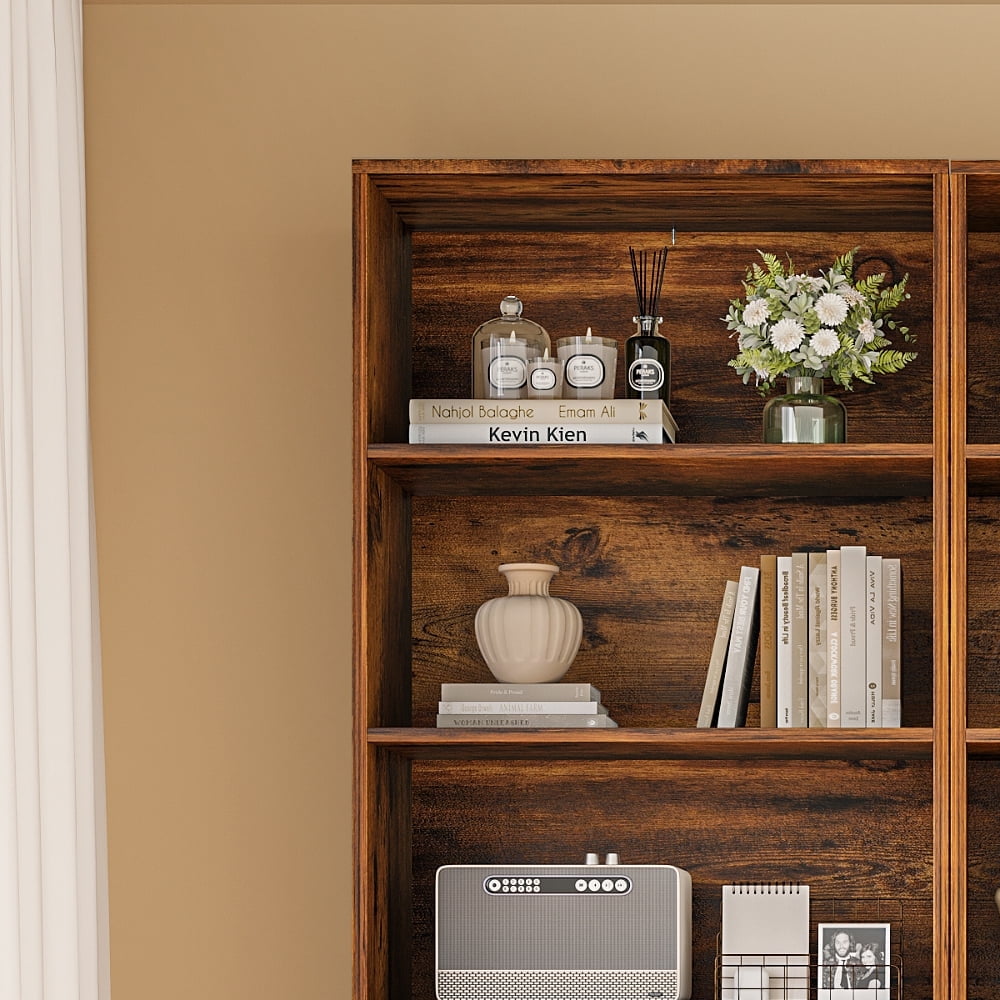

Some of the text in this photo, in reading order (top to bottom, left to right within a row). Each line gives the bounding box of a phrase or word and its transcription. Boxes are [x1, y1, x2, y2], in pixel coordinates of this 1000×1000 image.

[432, 405, 474, 419] Nahjol
[478, 405, 534, 420] Balaghe
[559, 405, 596, 418] Emam
[600, 405, 616, 418] Ali
[489, 426, 587, 442] Kevin Kien
